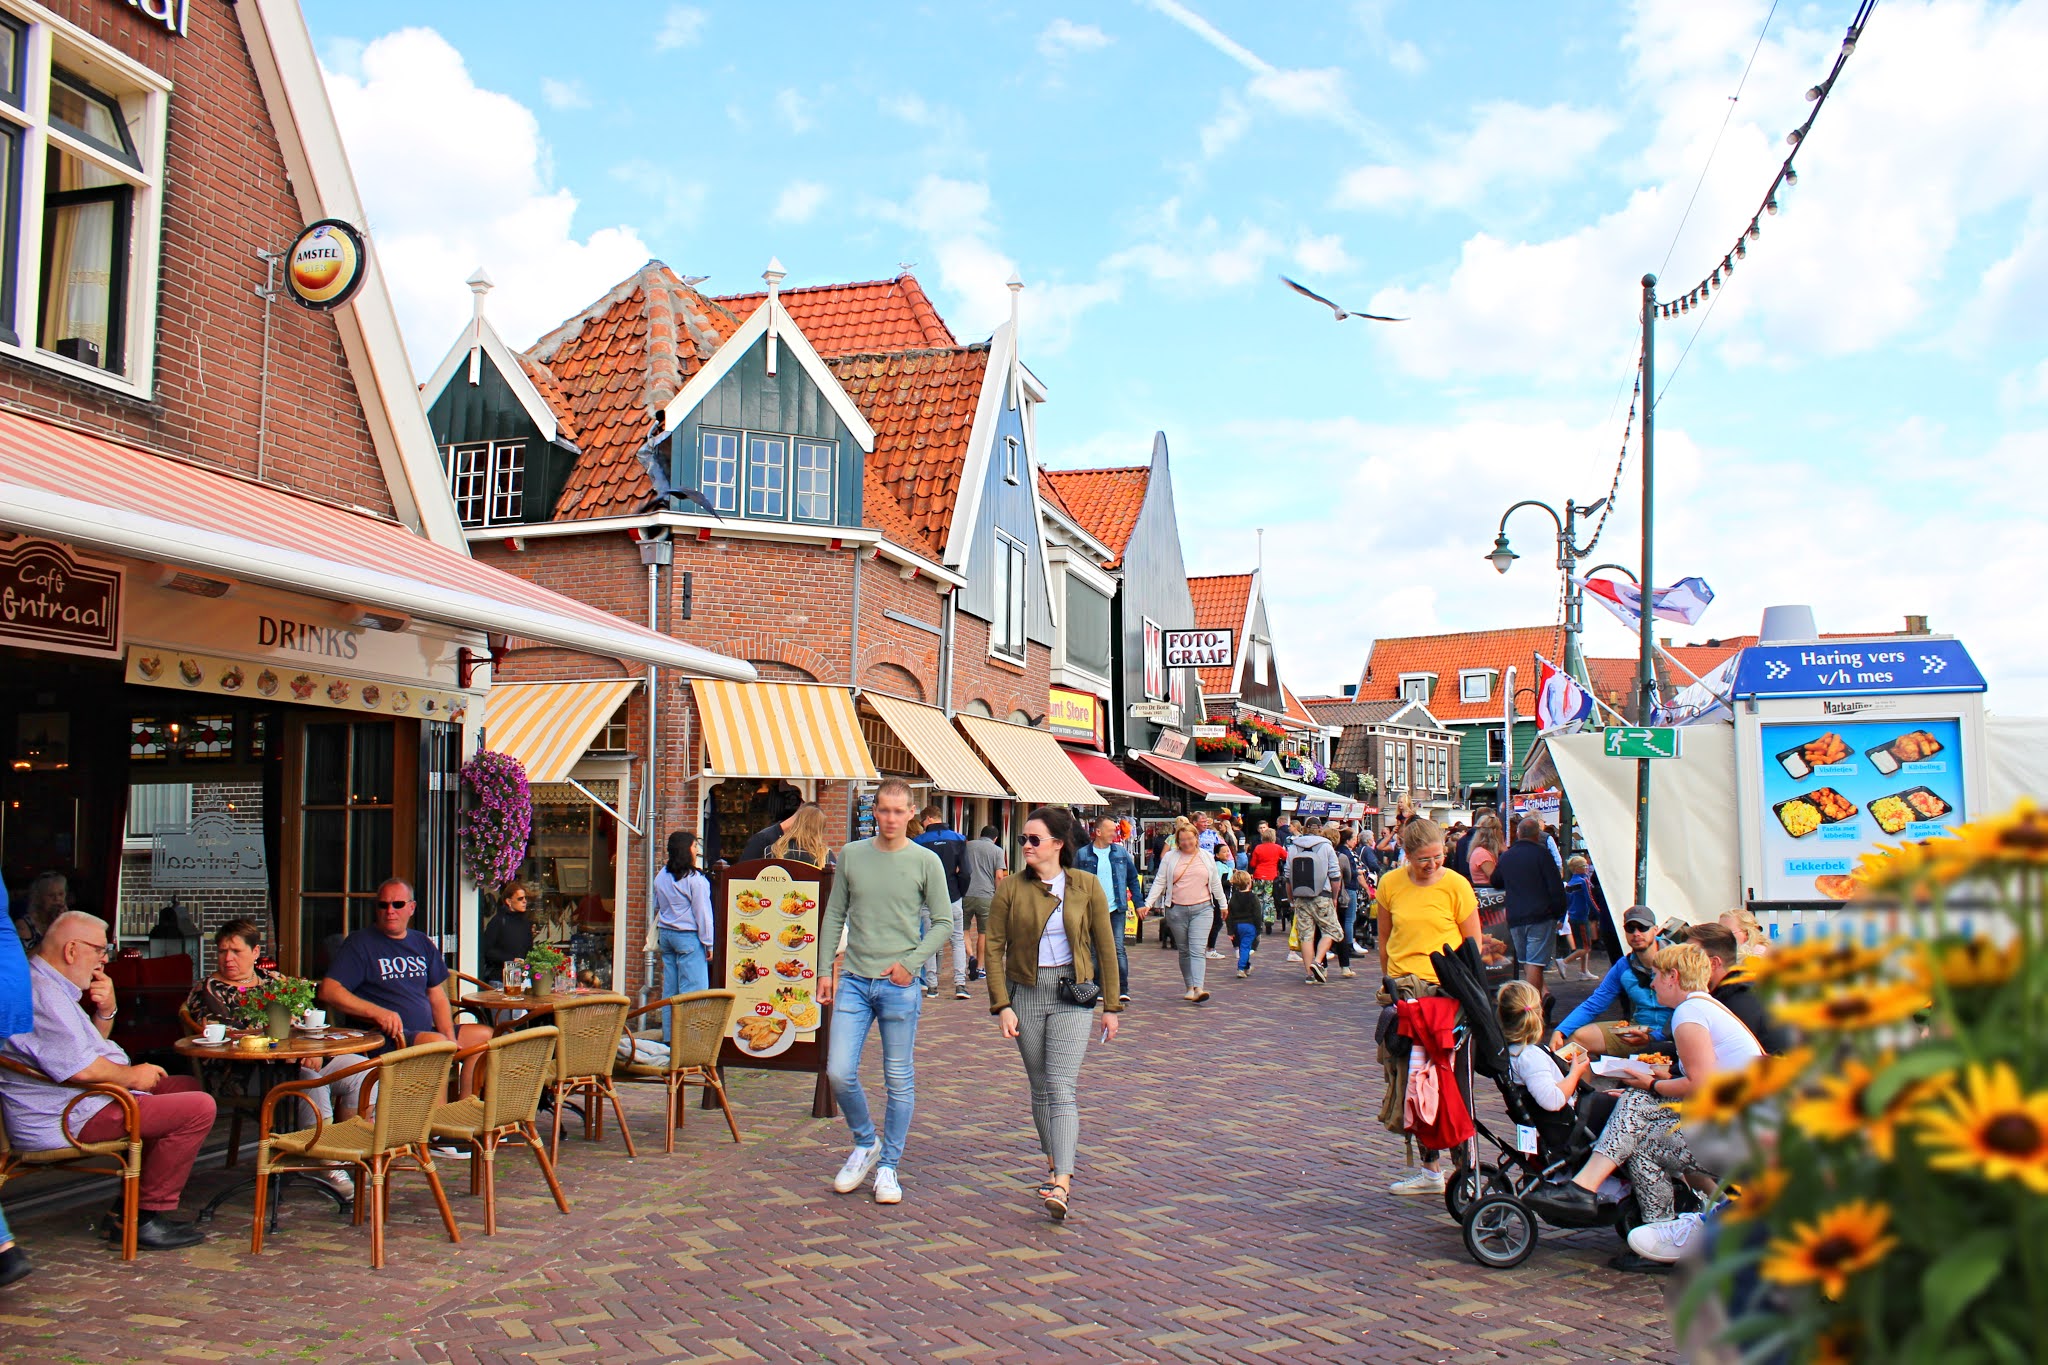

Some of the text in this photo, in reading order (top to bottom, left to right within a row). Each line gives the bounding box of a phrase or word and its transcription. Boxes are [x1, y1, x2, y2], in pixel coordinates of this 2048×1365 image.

[296, 248, 338, 262] AMSTEL
[18, 564, 65, 593] Café
[0, 586, 106, 628] entraal
[257, 615, 358, 660] DRINKS
[1168, 632, 1224, 648] FOTO-
[1168, 649, 1229, 665] GRAAF
[1800, 650, 1905, 669] Haring vers
[1817, 668, 1894, 686] v/h mes
[1066, 701, 1089, 722] Store
[1818, 766, 1853, 774] Visfrietjes
[1908, 763, 1941, 772] Kibbeling
[1523, 796, 1560, 811] Kibbelin
[1823, 832, 1855, 840] kibbeling
[1789, 861, 1846, 871] Lekkerbek
[378, 956, 427, 975] BOSS
